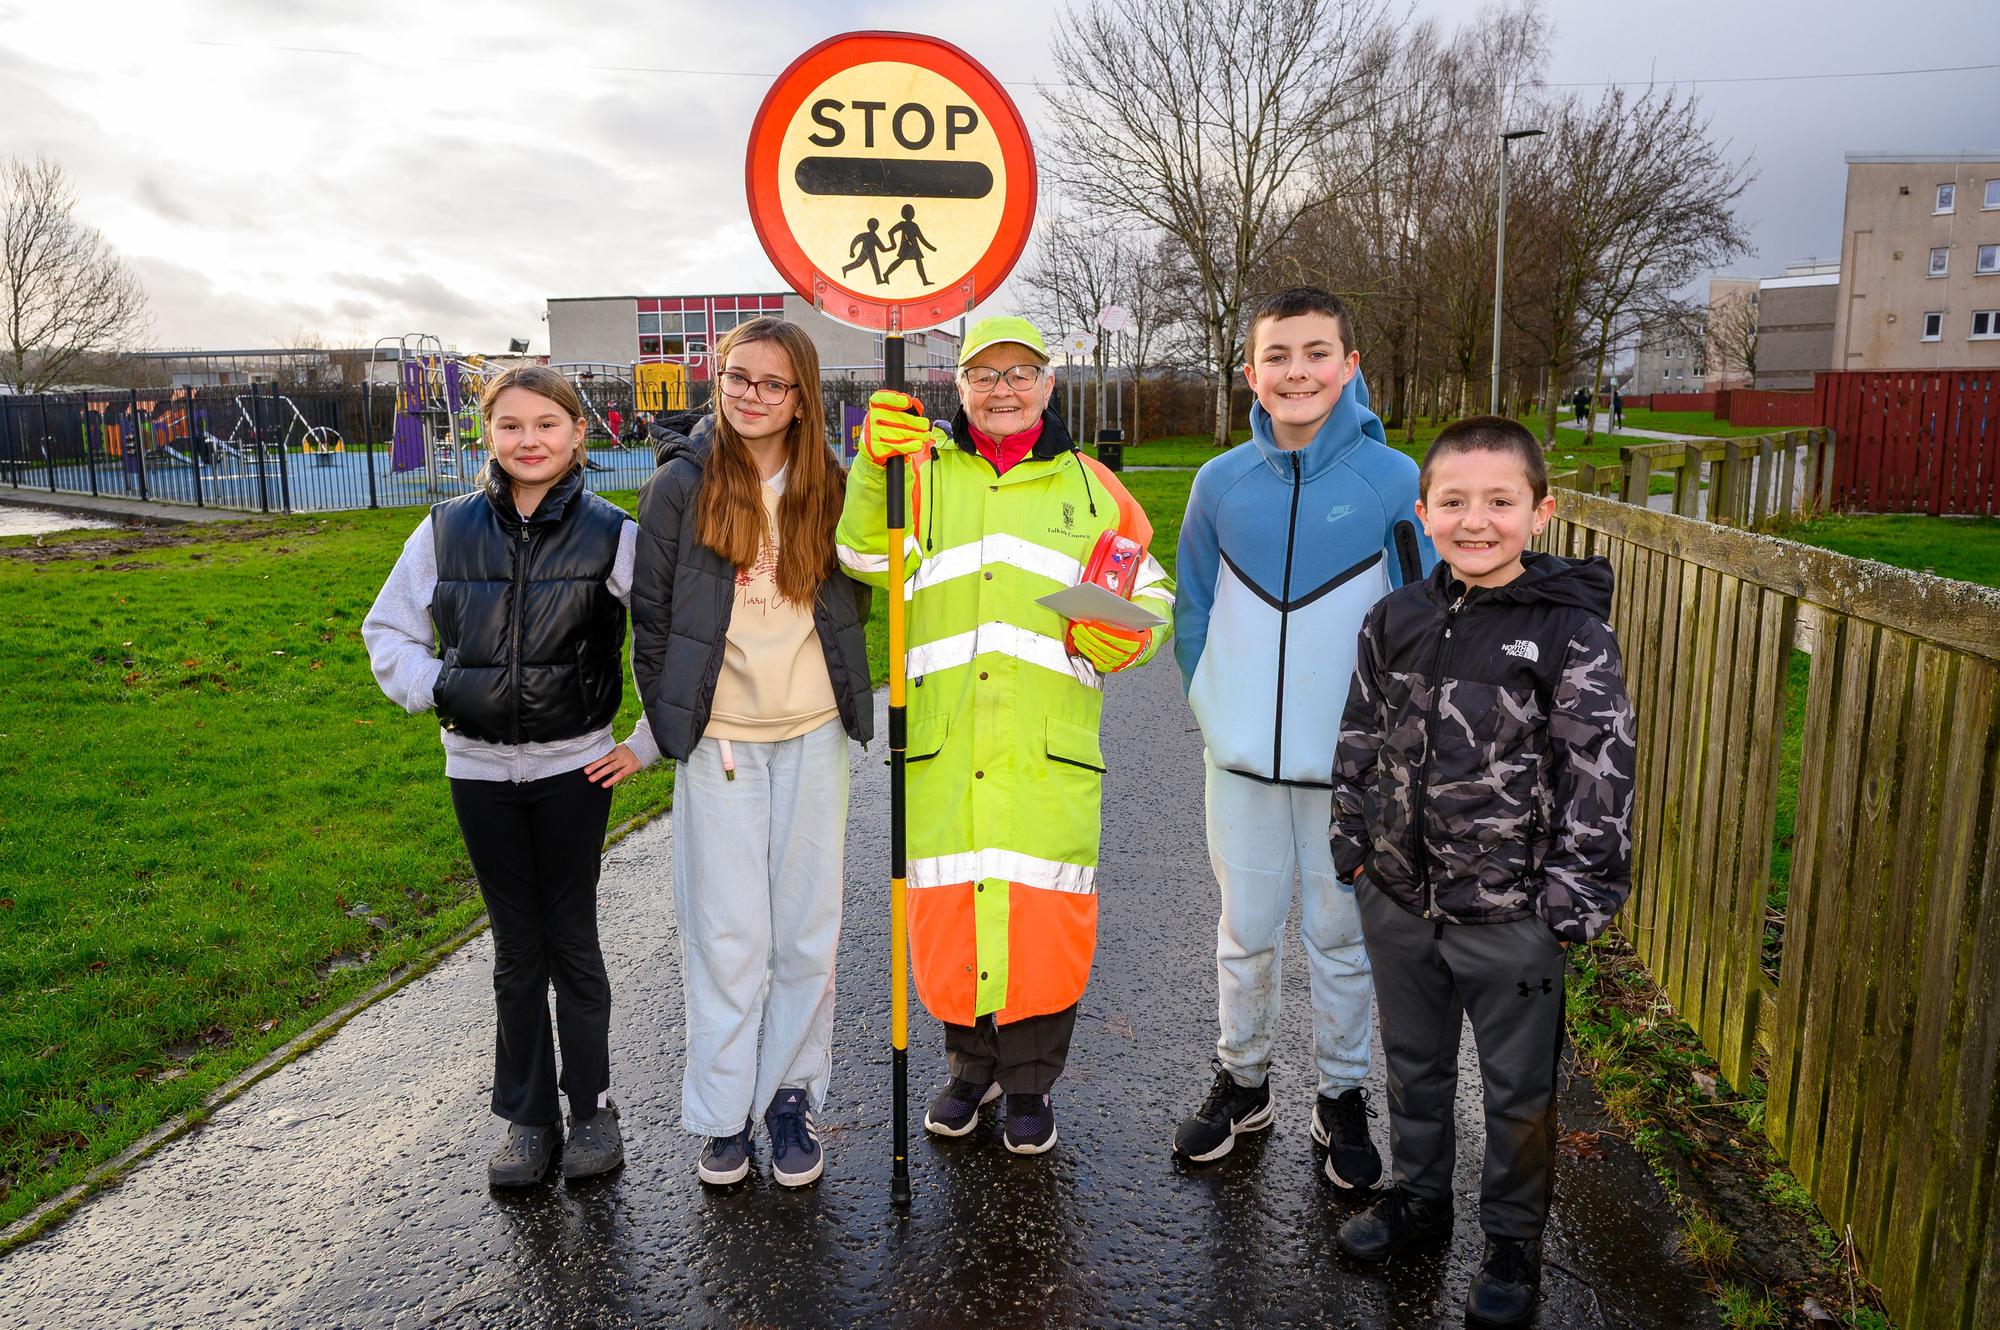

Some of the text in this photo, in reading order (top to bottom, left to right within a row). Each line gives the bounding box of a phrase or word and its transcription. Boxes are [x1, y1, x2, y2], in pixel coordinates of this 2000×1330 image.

[808, 98, 979, 151] STOP
[1331, 505, 1350, 514] NIKE
[1502, 644, 1526, 652] NORTH
